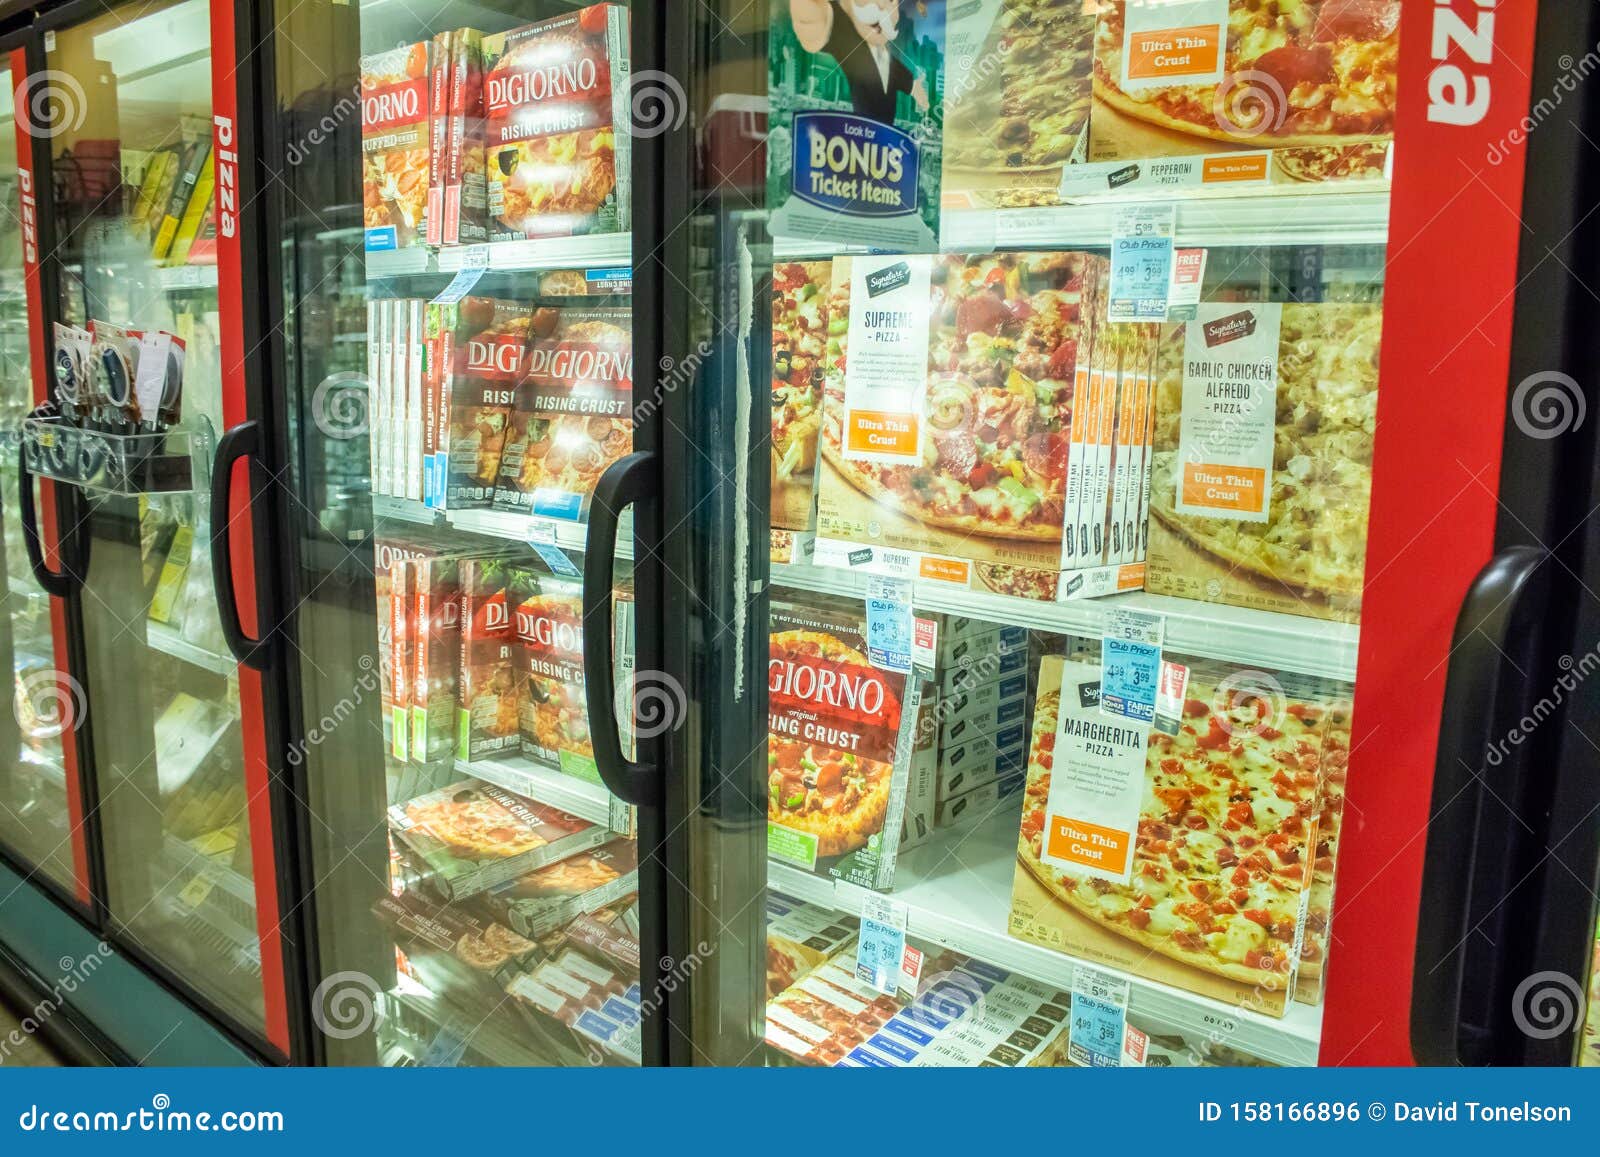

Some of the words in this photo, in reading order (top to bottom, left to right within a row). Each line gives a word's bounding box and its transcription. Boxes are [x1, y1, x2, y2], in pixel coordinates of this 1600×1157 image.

[1141, 37, 1173, 53] Ultra
[1176, 35, 1208, 51] Thin
[1153, 52, 1191, 68] Crust
[489, 58, 597, 110] DIGIORNO
[501, 121, 541, 141] RISING
[545, 111, 585, 131] CRUST
[844, 123, 864, 137] Look
[864, 125, 877, 139] for
[809, 128, 904, 183] BONUS
[214, 115, 239, 239] pizza
[1151, 163, 1192, 176] PEPPERONI
[810, 171, 858, 201] Ticket
[861, 180, 902, 206] Items
[17, 167, 35, 264] pizza
[1178, 254, 1200, 265] FREE
[864, 310, 914, 329] SUPREME
[1208, 318, 1248, 338] Signature
[875, 331, 901, 342] PIZZA
[1188, 362, 1223, 379] GARLIC
[1228, 364, 1272, 381] CHICKEN
[1206, 382, 1250, 400] ALFREDO
[535, 395, 577, 410] RISING
[579, 399, 625, 415] CRUST
[1214, 403, 1242, 414] PIZZA
[858, 419, 883, 431] Ultra
[885, 421, 910, 433] Thin
[868, 434, 898, 446] Crust
[1194, 472, 1223, 485] Ultra
[1226, 476, 1254, 488] Thin
[1206, 488, 1240, 501] Crust
[872, 600, 886, 610] Club
[778, 615, 791, 623] NOT
[822, 622, 833, 630] IT'S
[1110, 641, 1128, 652] Club
[1130, 645, 1156, 656] Price!
[531, 660, 571, 682] RISING
[804, 722, 860, 750] CRUST
[1064, 718, 1140, 749] MARGHERITA
[1086, 743, 1114, 758] PIZZA
[481, 783, 512, 809] RISING
[510, 801, 546, 829] CRUST
[1060, 825, 1089, 842] Ultra
[1091, 834, 1118, 850] Thin
[1071, 844, 1104, 860] Crust
[1078, 996, 1096, 1008] Club
[1096, 1004, 1120, 1016] Price!
